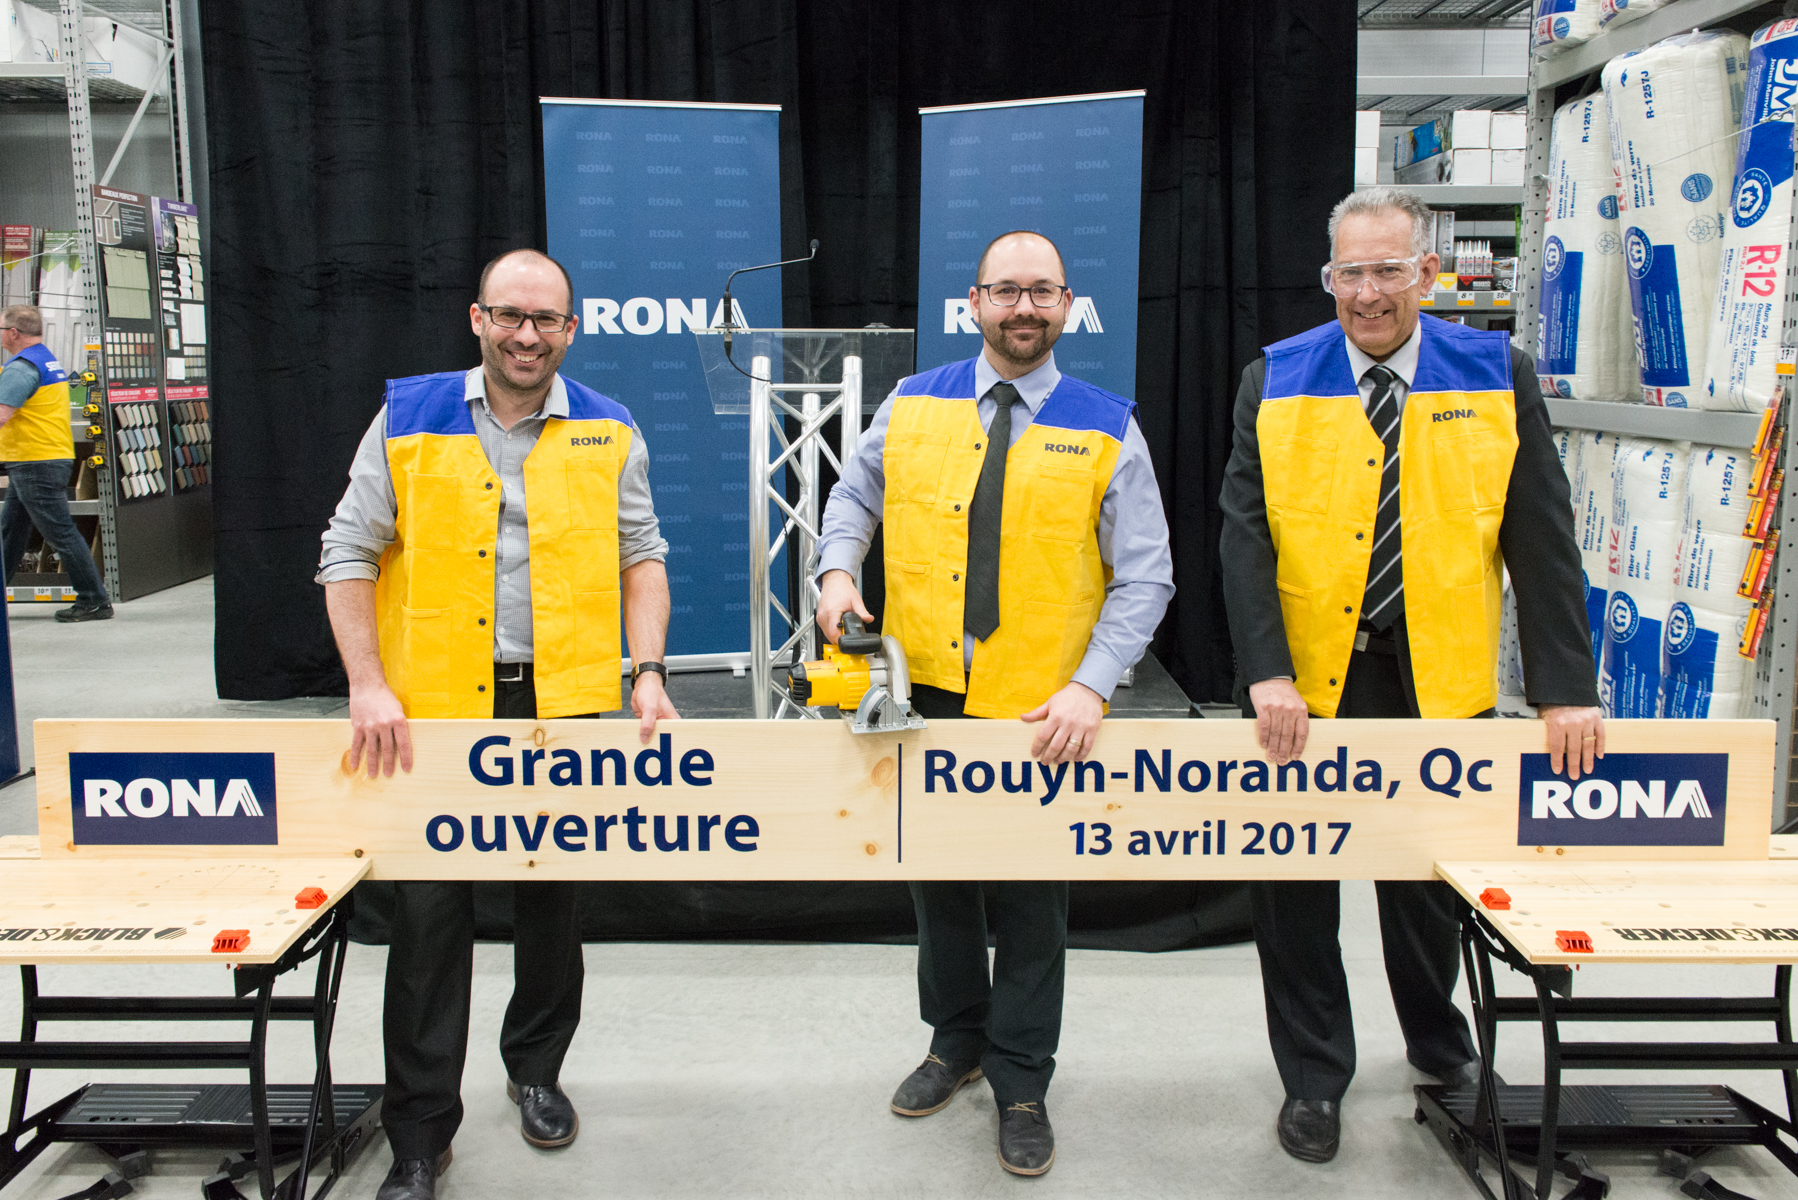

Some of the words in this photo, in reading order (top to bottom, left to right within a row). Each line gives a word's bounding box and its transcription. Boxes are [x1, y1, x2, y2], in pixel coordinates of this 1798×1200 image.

[1767, 58, 1776, 83] Johns
[1641, 70, 1655, 119] R-1257J
[1582, 100, 1593, 143] R-1257J
[576, 131, 613, 141] RONA
[1011, 131, 1045, 142] RONA
[1075, 126, 1110, 137] RONA
[646, 133, 682, 143] RONA
[713, 134, 749, 144] RONA
[950, 136, 981, 146] RONA
[1627, 140, 1635, 166] verre
[577, 164, 614, 173] RONA
[647, 165, 683, 175] RONA
[1011, 163, 1044, 173] RONA
[1075, 160, 1110, 170] RONA
[714, 167, 749, 176] RONA
[950, 167, 980, 177] RONA
[1559, 185, 1564, 195] de
[1687, 179, 1699, 199] SANS
[578, 196, 615, 205] RONA
[648, 197, 684, 206] RONA
[715, 198, 750, 208] RONA
[947, 199, 980, 208] RONA
[1010, 195, 1043, 205] RONA
[1074, 192, 1109, 203] RONA
[1649, 197, 1655, 206] 20
[579, 228, 616, 238] RONA
[649, 229, 684, 239] RONA
[716, 230, 750, 239] RONA
[946, 230, 978, 240] RONA
[1073, 225, 1108, 236] RONA
[581, 260, 617, 270] RONA
[650, 261, 685, 270] RONA
[1726, 248, 1734, 275] Fibre
[1742, 244, 1782, 297] R-12
[1724, 279, 1730, 291] de
[582, 297, 751, 335] RONA
[944, 296, 1104, 334] RA
[1763, 303, 1772, 322] Murs
[1753, 302, 1764, 337] Ossature
[1729, 313, 1738, 344] Morceaux
[1761, 324, 1769, 338] 2x4
[1749, 350, 1757, 366] bois
[1432, 409, 1478, 423] RONA
[570, 435, 614, 446] RONA
[1045, 443, 1091, 456] RONA
[1559, 431, 1569, 467] -1257J
[1659, 452, 1674, 499] R-1257J
[1720, 456, 1737, 506] R-1257J
[1582, 528, 1590, 550] Fibre
[1586, 515, 1591, 526] de
[1597, 516, 1605, 544] Morceaux
[1693, 519, 1701, 545] verre
[1629, 525, 1638, 551] Glass
[723, 543, 750, 552] RON
[1691, 548, 1698, 560] de
[1704, 548, 1713, 580] Morceaux
[724, 573, 750, 582] RON
[1644, 572, 1650, 580] 20
[1687, 563, 1696, 588] Fibre
[1703, 582, 1709, 591] 20
[725, 603, 750, 611] RON
[468, 733, 715, 787] Grande
[923, 745, 1401, 806] Rouyn-Noranda,
[1419, 746, 1494, 799] Qc
[83, 778, 264, 818] RONA
[1532, 779, 1712, 820] RONA
[425, 805, 760, 852] ouverture
[1068, 821, 1113, 855] 13
[1128, 819, 1226, 855] avril
[1240, 821, 1352, 855] 2017
[1613, 928, 1798, 941] CK&DECKER
